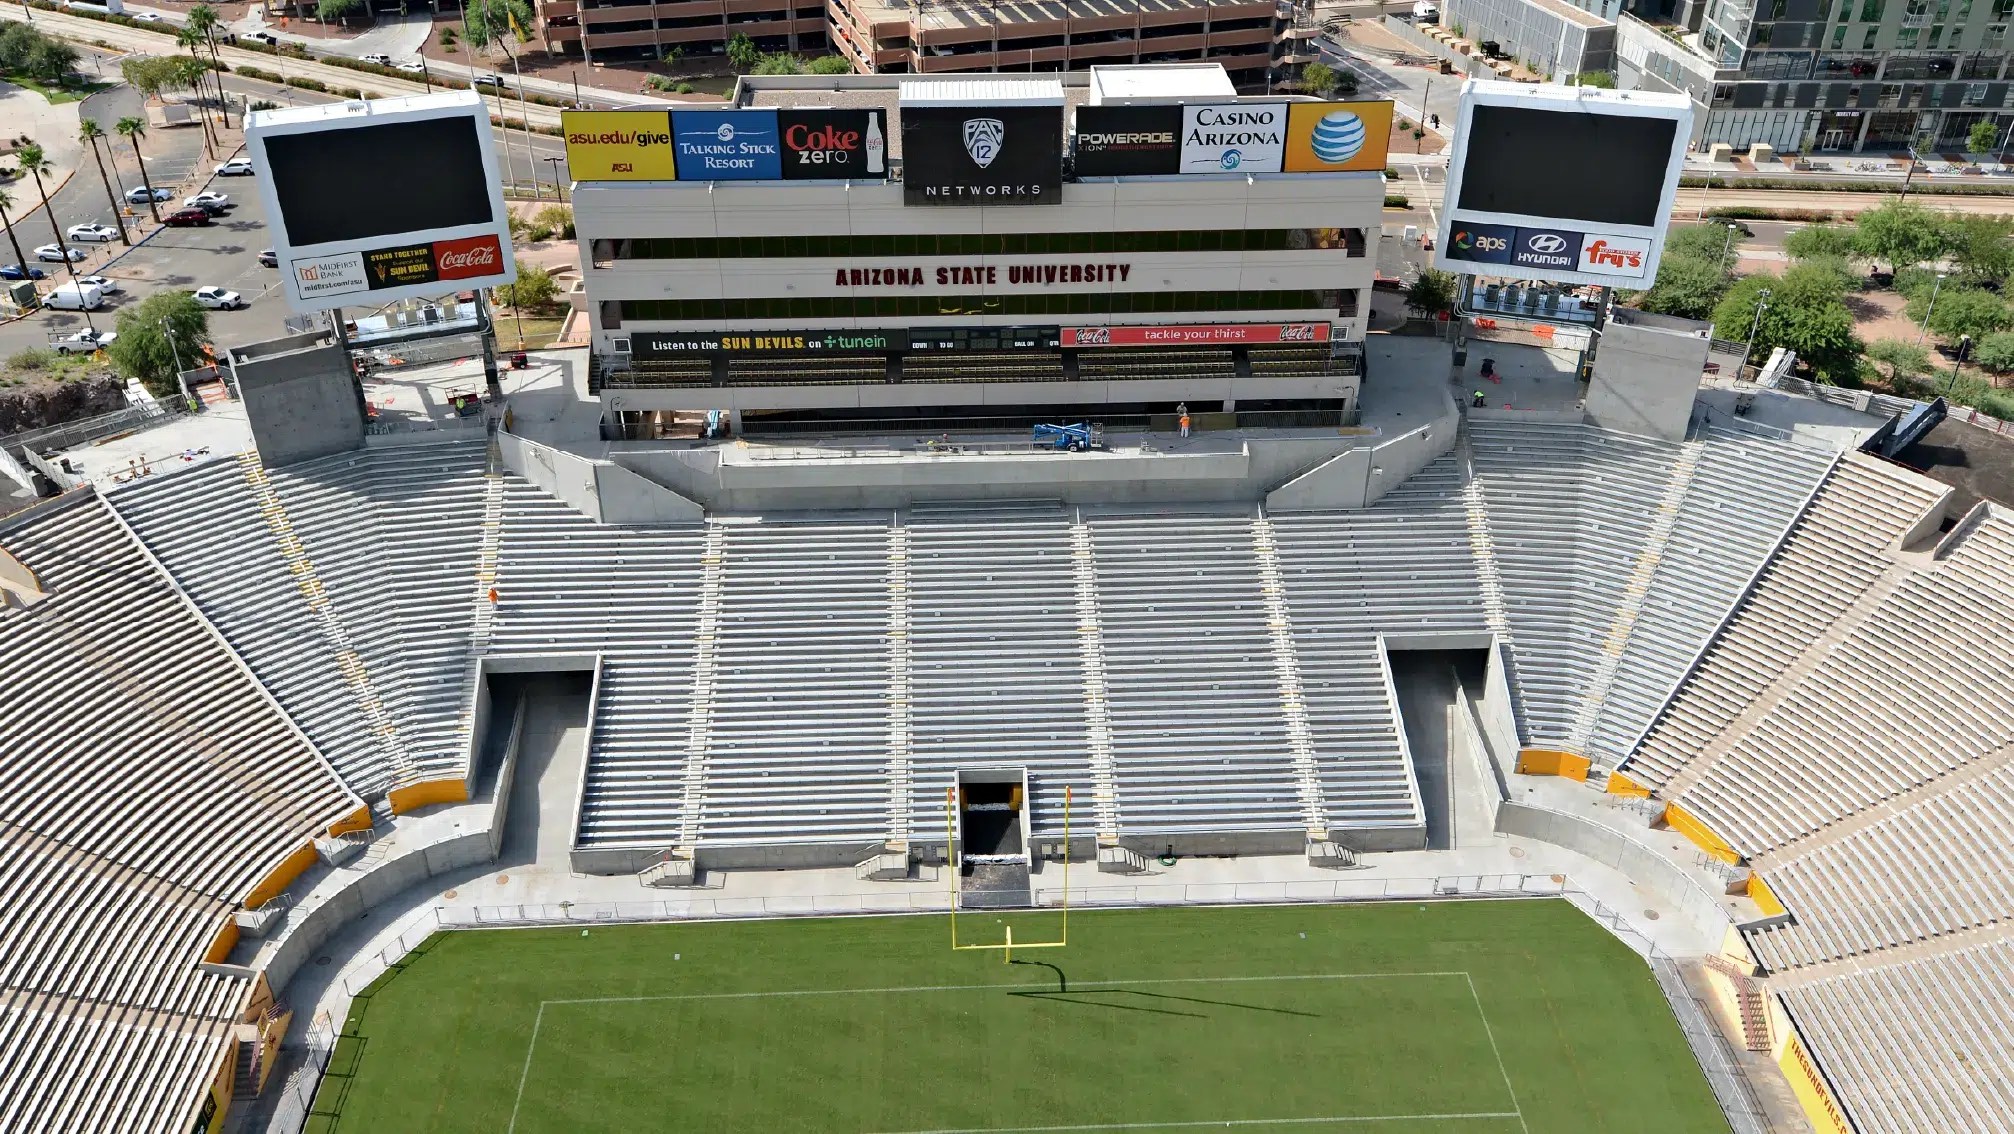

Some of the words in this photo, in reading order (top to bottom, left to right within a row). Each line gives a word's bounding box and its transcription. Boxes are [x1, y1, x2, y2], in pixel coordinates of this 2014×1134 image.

[1196, 108, 1274, 126] CASINO
[568, 130, 670, 147] asu.edu/give
[785, 124, 859, 151] Coke
[1185, 128, 1280, 146] ARIZONA
[679, 142, 736, 155] TALKING
[739, 142, 776, 154] STICK
[976, 145, 992, 159] 12
[704, 156, 755, 169] RESORT
[798, 150, 848, 164] zero
[611, 163, 633, 173] ASU
[926, 184, 1041, 196] NETWORKS
[1475, 235, 1507, 252] aps
[394, 248, 428, 259] TOGETHER
[440, 246, 495, 270] Coca-Cola
[1517, 252, 1571, 266] HYUNDAI
[1585, 240, 1642, 268] fry's
[320, 270, 344, 280] BANK
[390, 266, 407, 276] SUN
[408, 263, 430, 274] DEVIL
[835, 267, 925, 286] ARIZONA
[936, 266, 996, 285] STATE
[1008, 264, 1131, 284] UNIVERSITY
[1145, 330, 1181, 339] tackle
[1184, 330, 1212, 341] your
[1214, 328, 1246, 339] thirst
[652, 341, 685, 350] Listen
[687, 341, 699, 350] to
[700, 341, 719, 350] the
[721, 337, 751, 349] SUN
[808, 340, 822, 349] on
[837, 334, 887, 349] tunein
